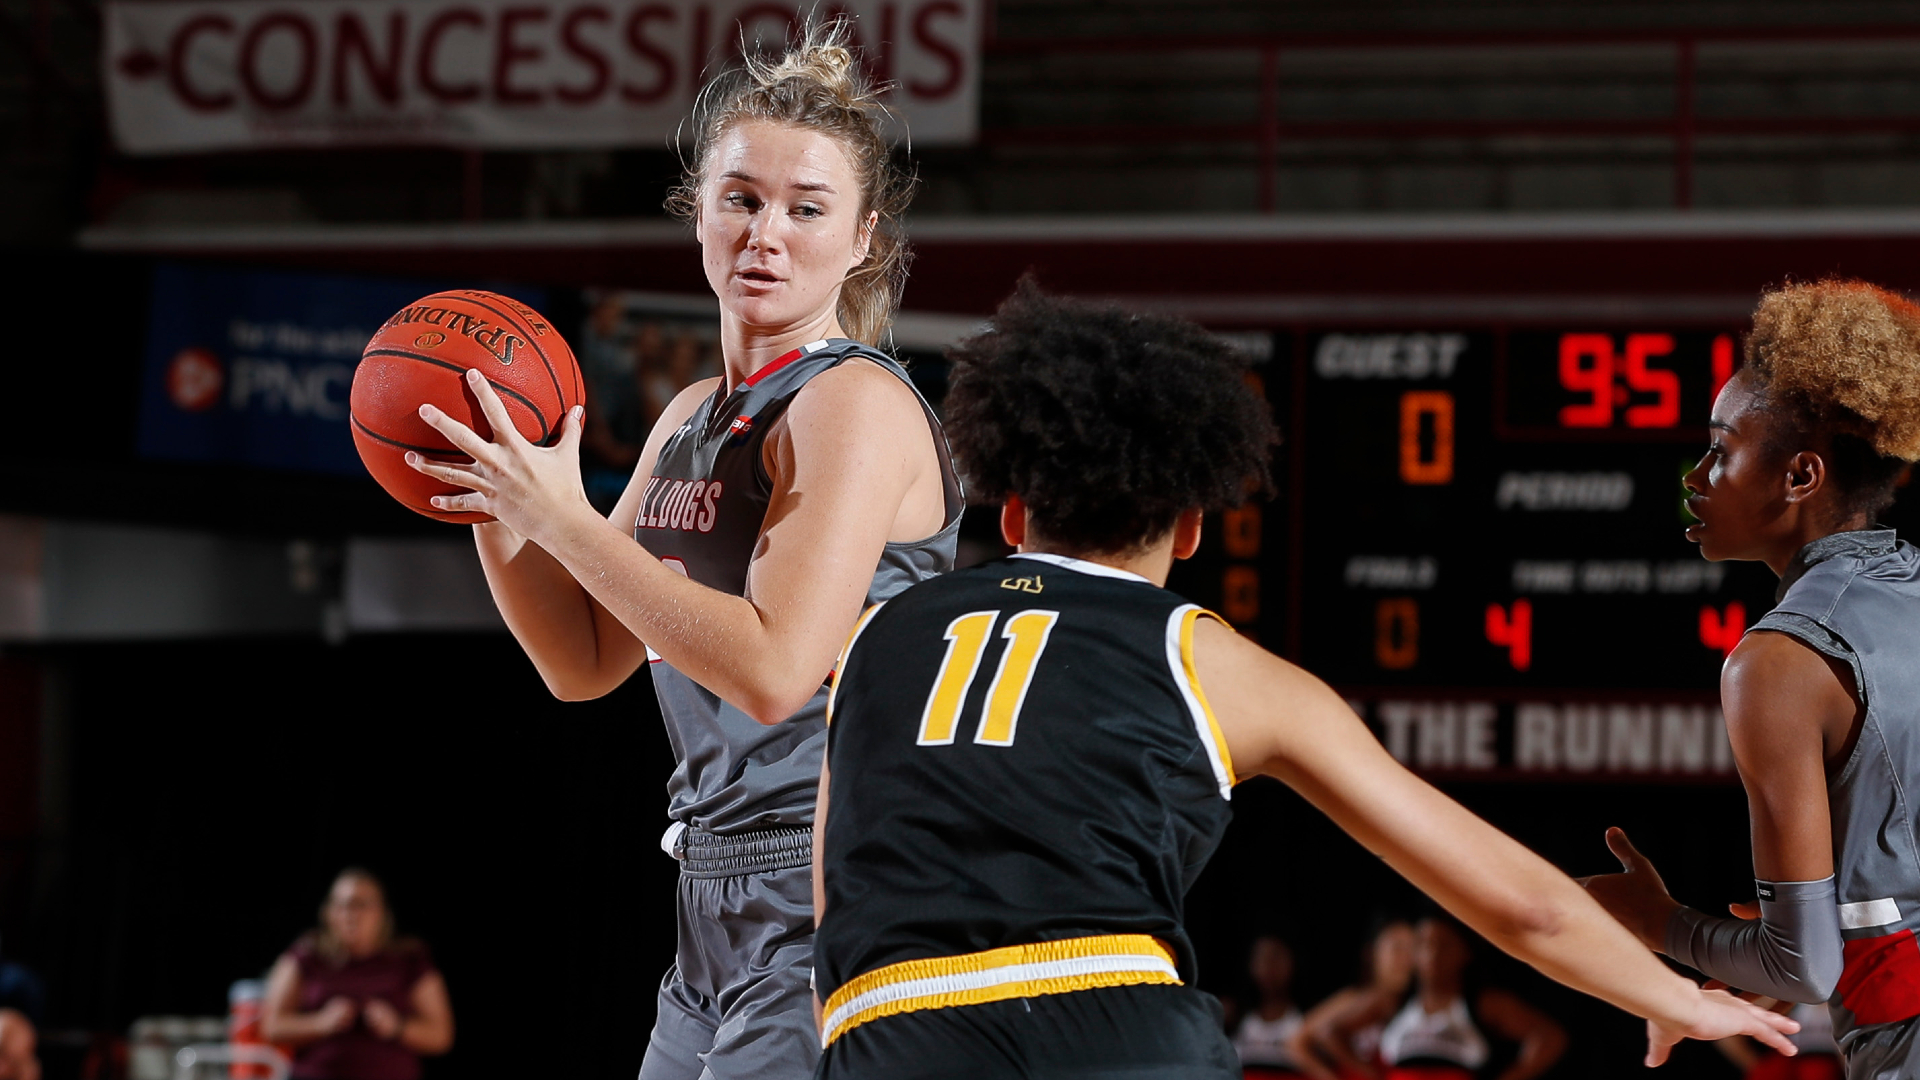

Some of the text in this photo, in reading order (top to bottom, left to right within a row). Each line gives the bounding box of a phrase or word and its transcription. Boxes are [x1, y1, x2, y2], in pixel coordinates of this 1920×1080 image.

[230, 356, 351, 420] PNC
[1315, 333, 1466, 379] GUEST
[1399, 390, 1455, 485] 0
[1496, 471, 1634, 511] PERIOD
[1483, 597, 1534, 672] 4
[1698, 599, 1747, 658] 4
[916, 609, 1060, 747] 11
[1378, 702, 1498, 767] THE
